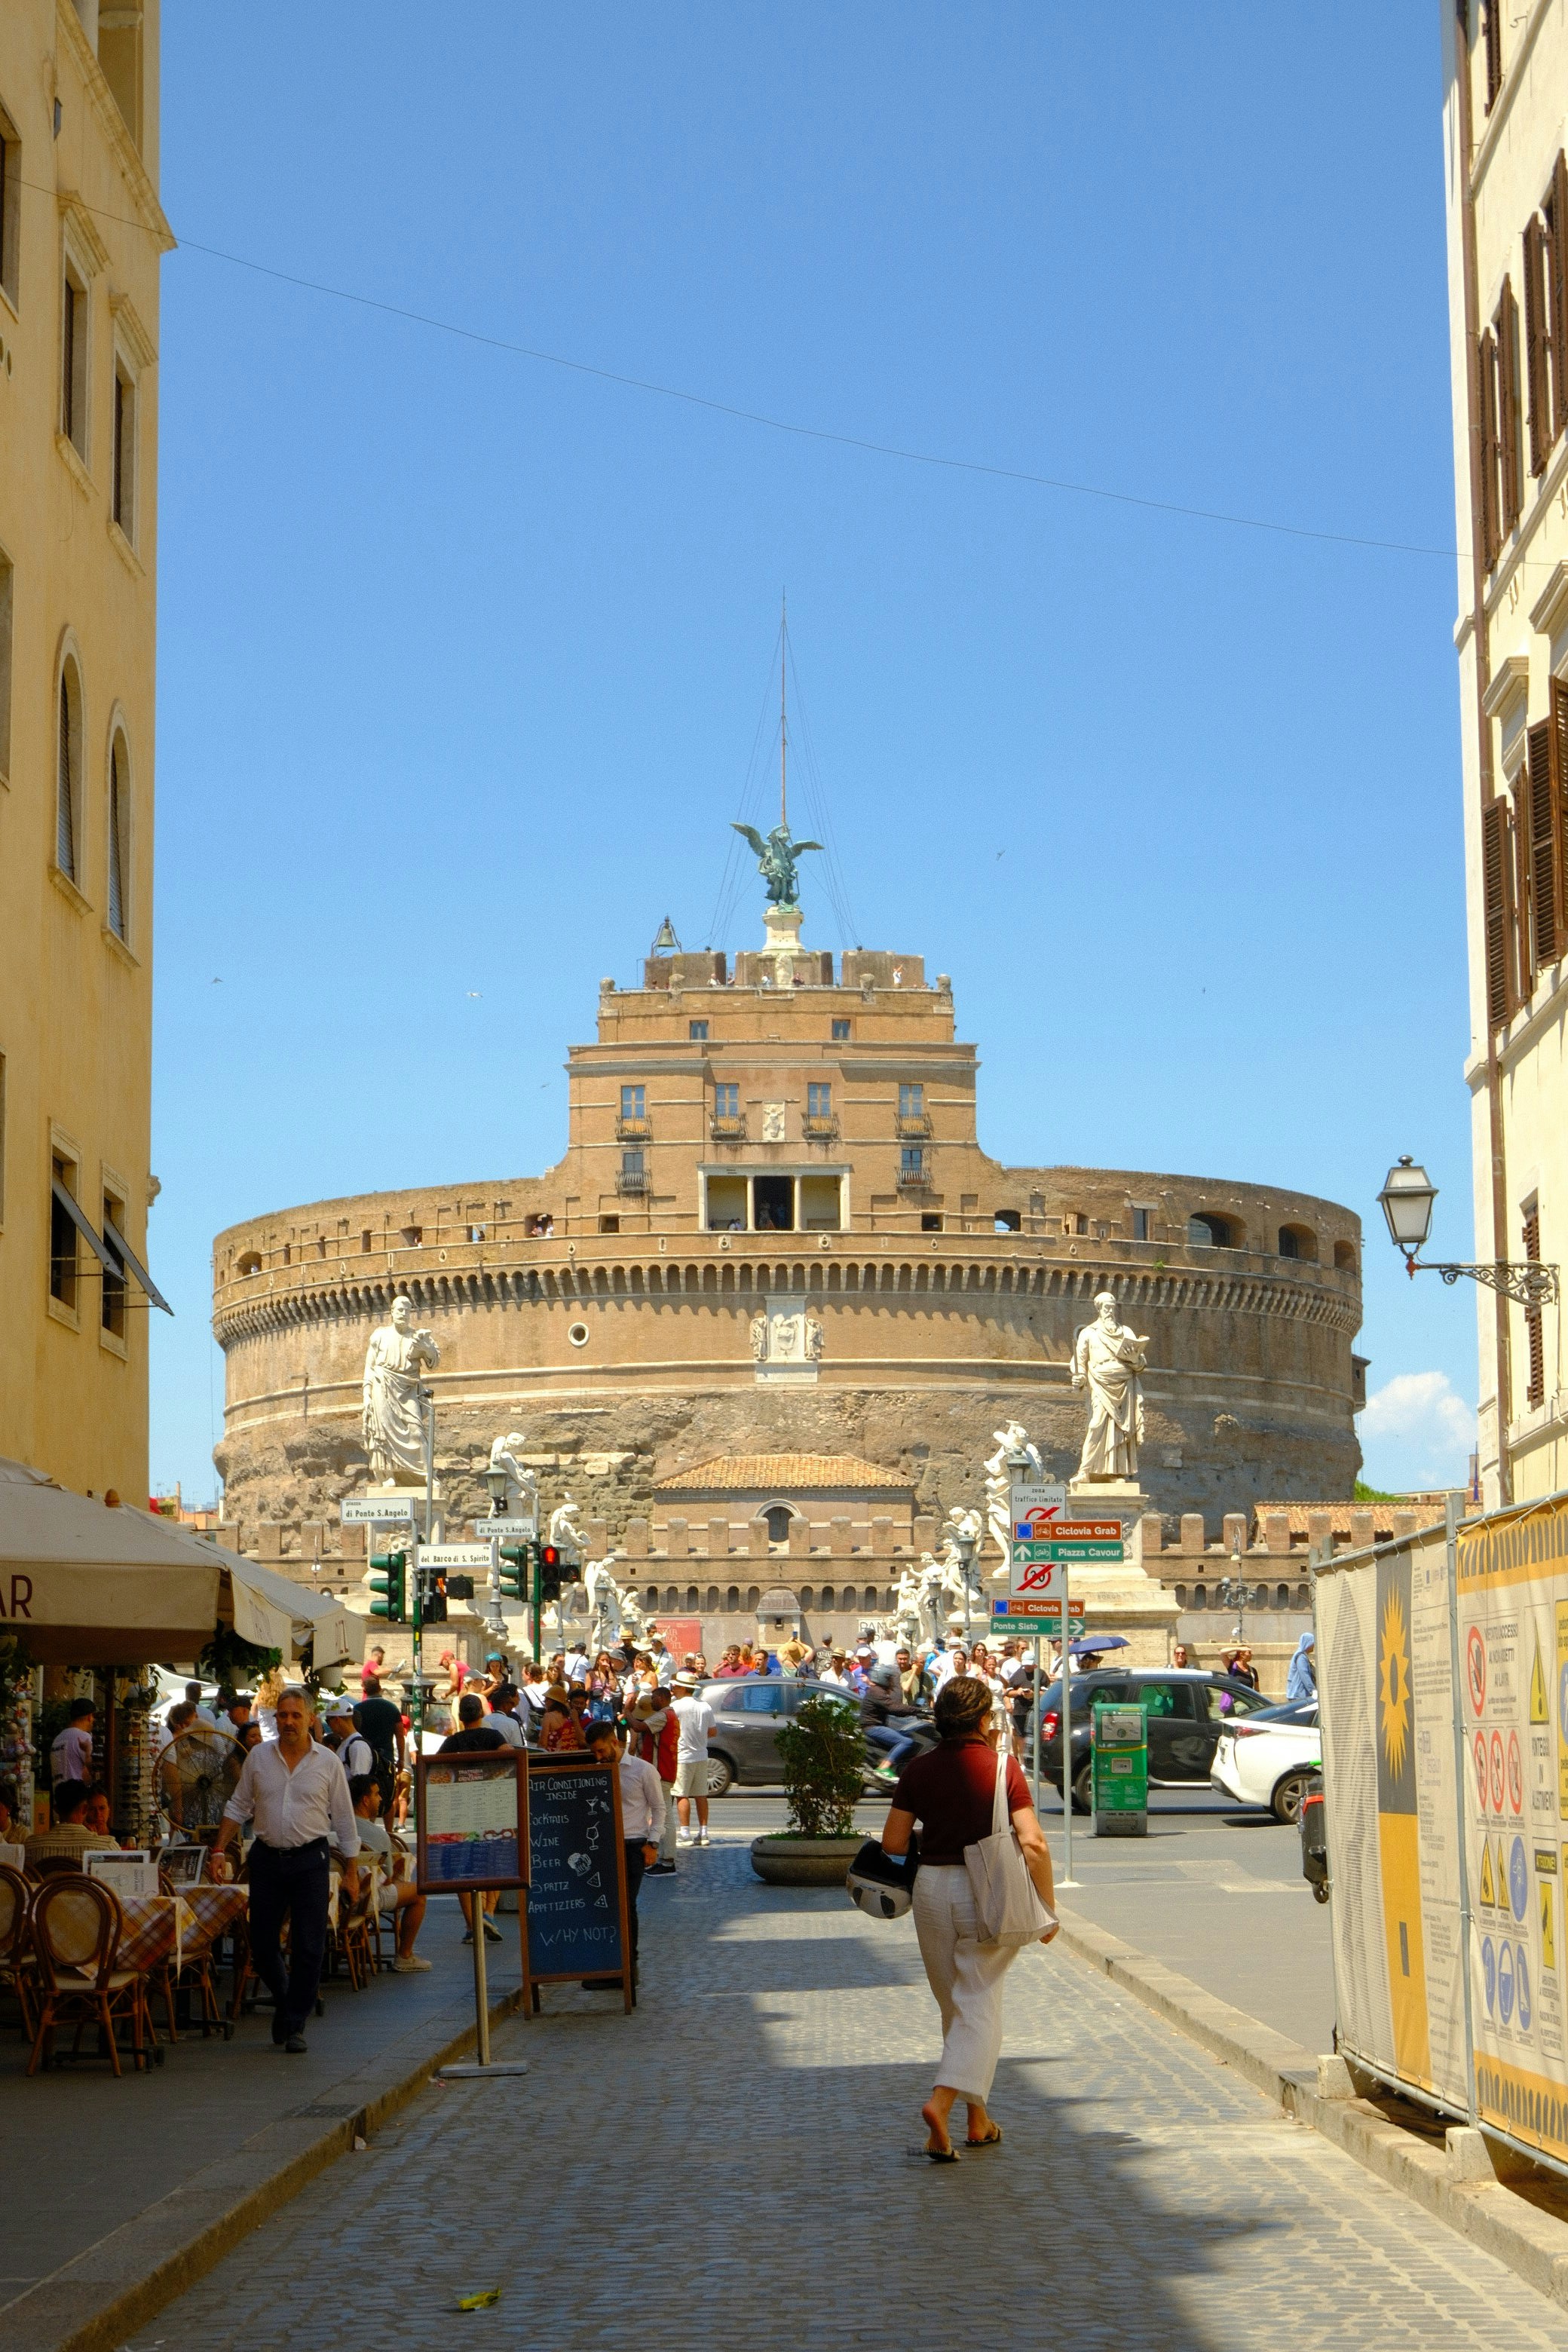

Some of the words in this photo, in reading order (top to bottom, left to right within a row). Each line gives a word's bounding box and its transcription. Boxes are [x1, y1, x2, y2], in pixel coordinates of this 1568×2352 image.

[1055, 1527, 1092, 1535] Ciclovia
[1094, 1527, 1117, 1535] Grab
[1058, 1548, 1086, 1557] Piazza
[1089, 1548, 1120, 1557] Cavour
[470, 1554, 490, 1563] Spirito
[1027, 1604, 1059, 1612] Ciclovia
[546, 1790, 577, 1800] INSIDE
[529, 1832, 560, 1847] WINE
[531, 1854, 561, 1869] BEER
[540, 1928, 578, 1946] WHY
[583, 1925, 617, 1943] NOT?
